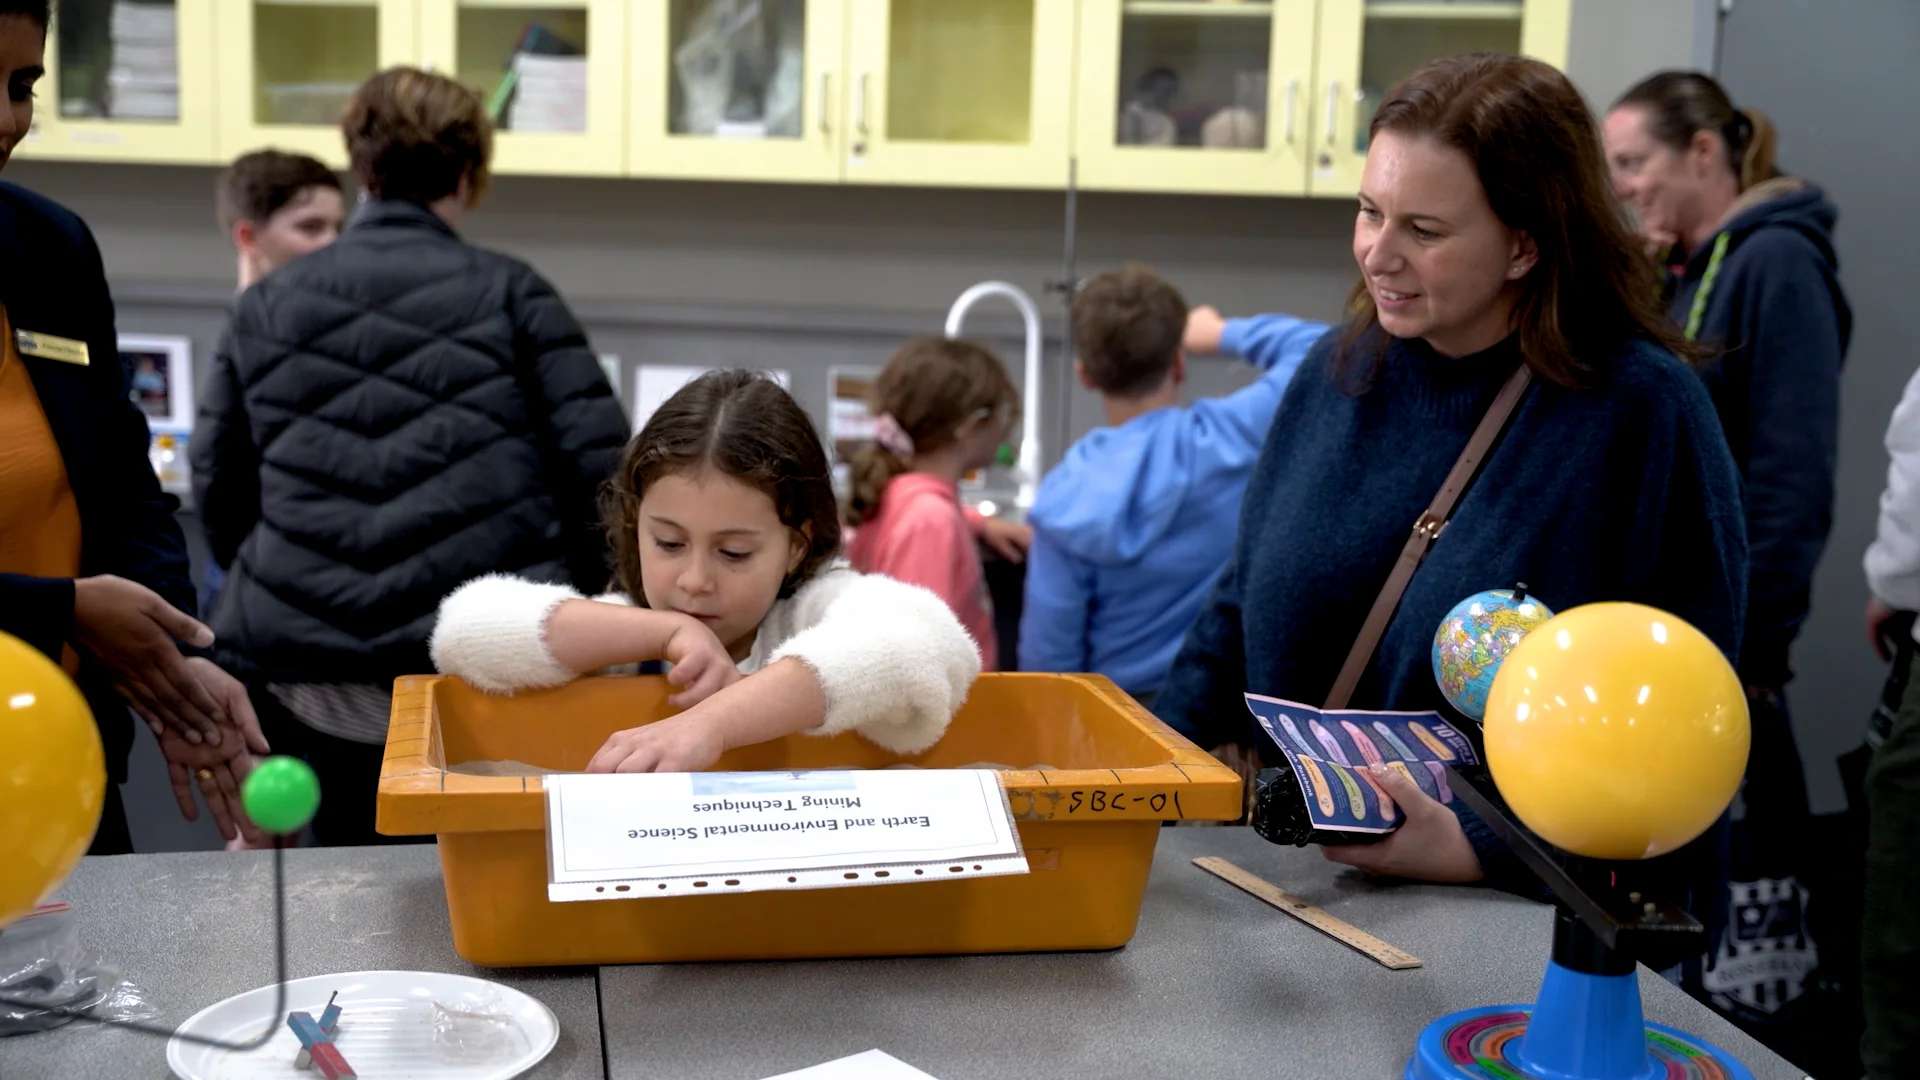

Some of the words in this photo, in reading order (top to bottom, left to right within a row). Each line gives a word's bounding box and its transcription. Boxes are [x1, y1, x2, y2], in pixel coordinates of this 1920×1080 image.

[1431, 723, 1457, 738] 10
[1297, 764, 1314, 797] Rosebank
[692, 799, 798, 813] Techniques
[801, 795, 862, 809] Mining
[1069, 790, 1184, 819] SBC-01
[704, 819, 839, 839] Environmental
[845, 818, 876, 829] and
[881, 816, 931, 828] Earth
[627, 826, 698, 839] Science
